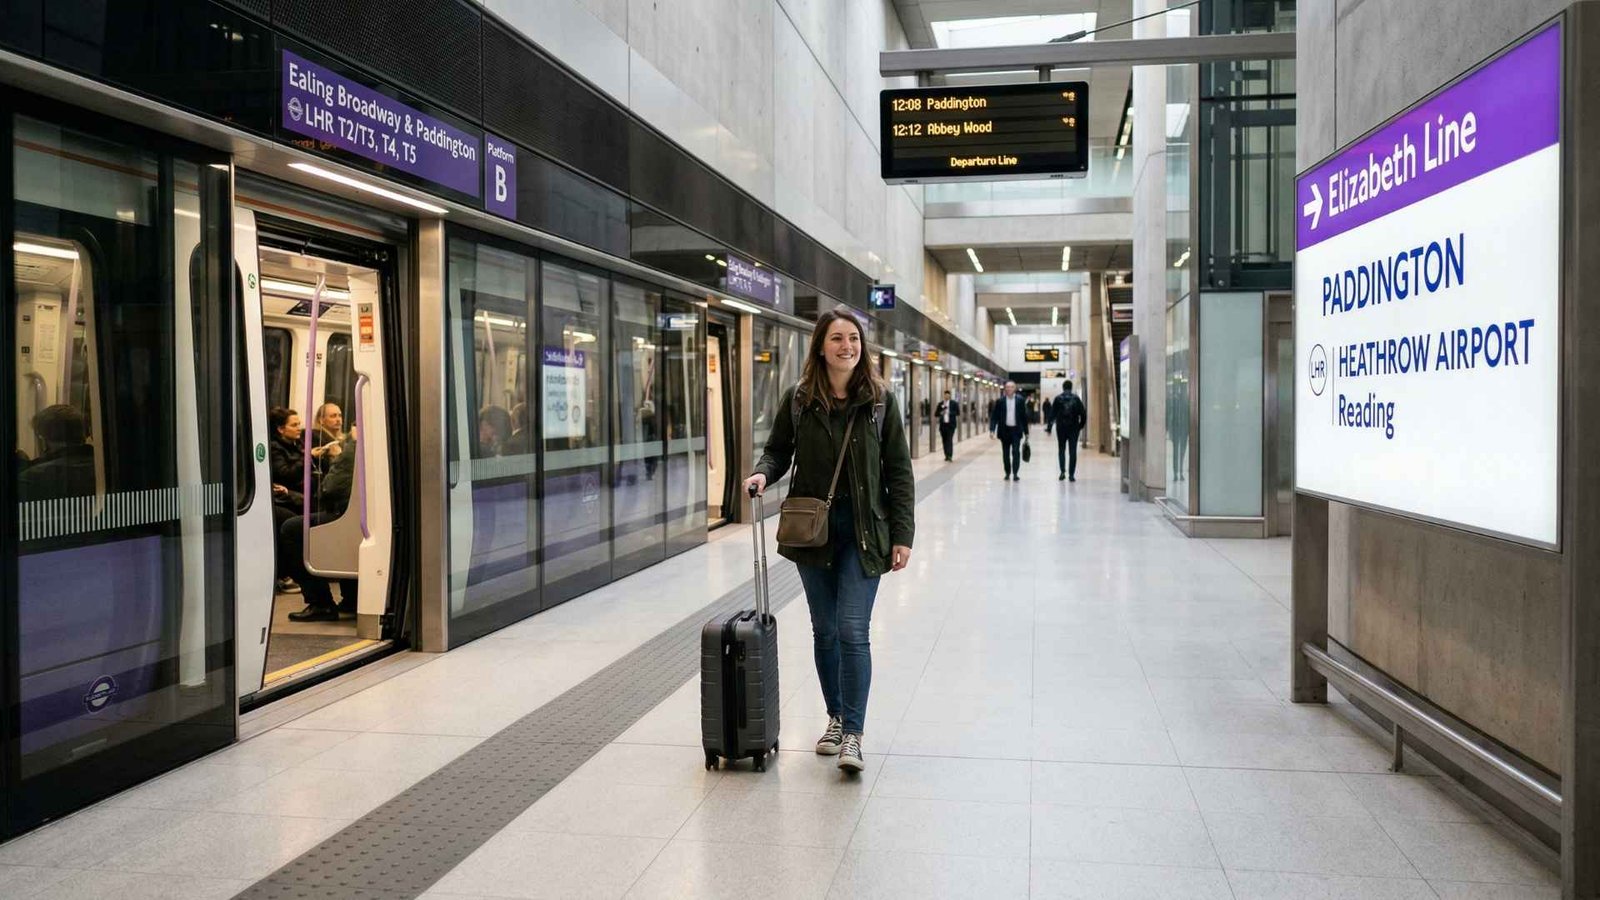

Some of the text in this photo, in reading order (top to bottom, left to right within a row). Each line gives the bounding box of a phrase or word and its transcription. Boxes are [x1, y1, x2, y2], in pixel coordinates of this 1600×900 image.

[289, 62, 476, 161] Ealing Broadway & Paddington
[892, 97, 987, 112] 12:08 Paddington
[305, 104, 334, 134] LHR
[338, 116, 378, 152] T2/T3,
[381, 133, 400, 161] T4,
[402, 142, 417, 164] T5
[893, 121, 993, 137] 12:12 Abbey Wood
[487, 142, 514, 164] Platform
[998, 155, 1018, 166] Line
[1328, 111, 1477, 218] Elizabeth Line
[495, 164, 508, 203] B
[1322, 232, 1464, 317] PADDINGTON
[1310, 360, 1325, 380] LHR
[1338, 319, 1535, 378] HEATHROW AIRPORT
[1338, 393, 1395, 440] Reading
